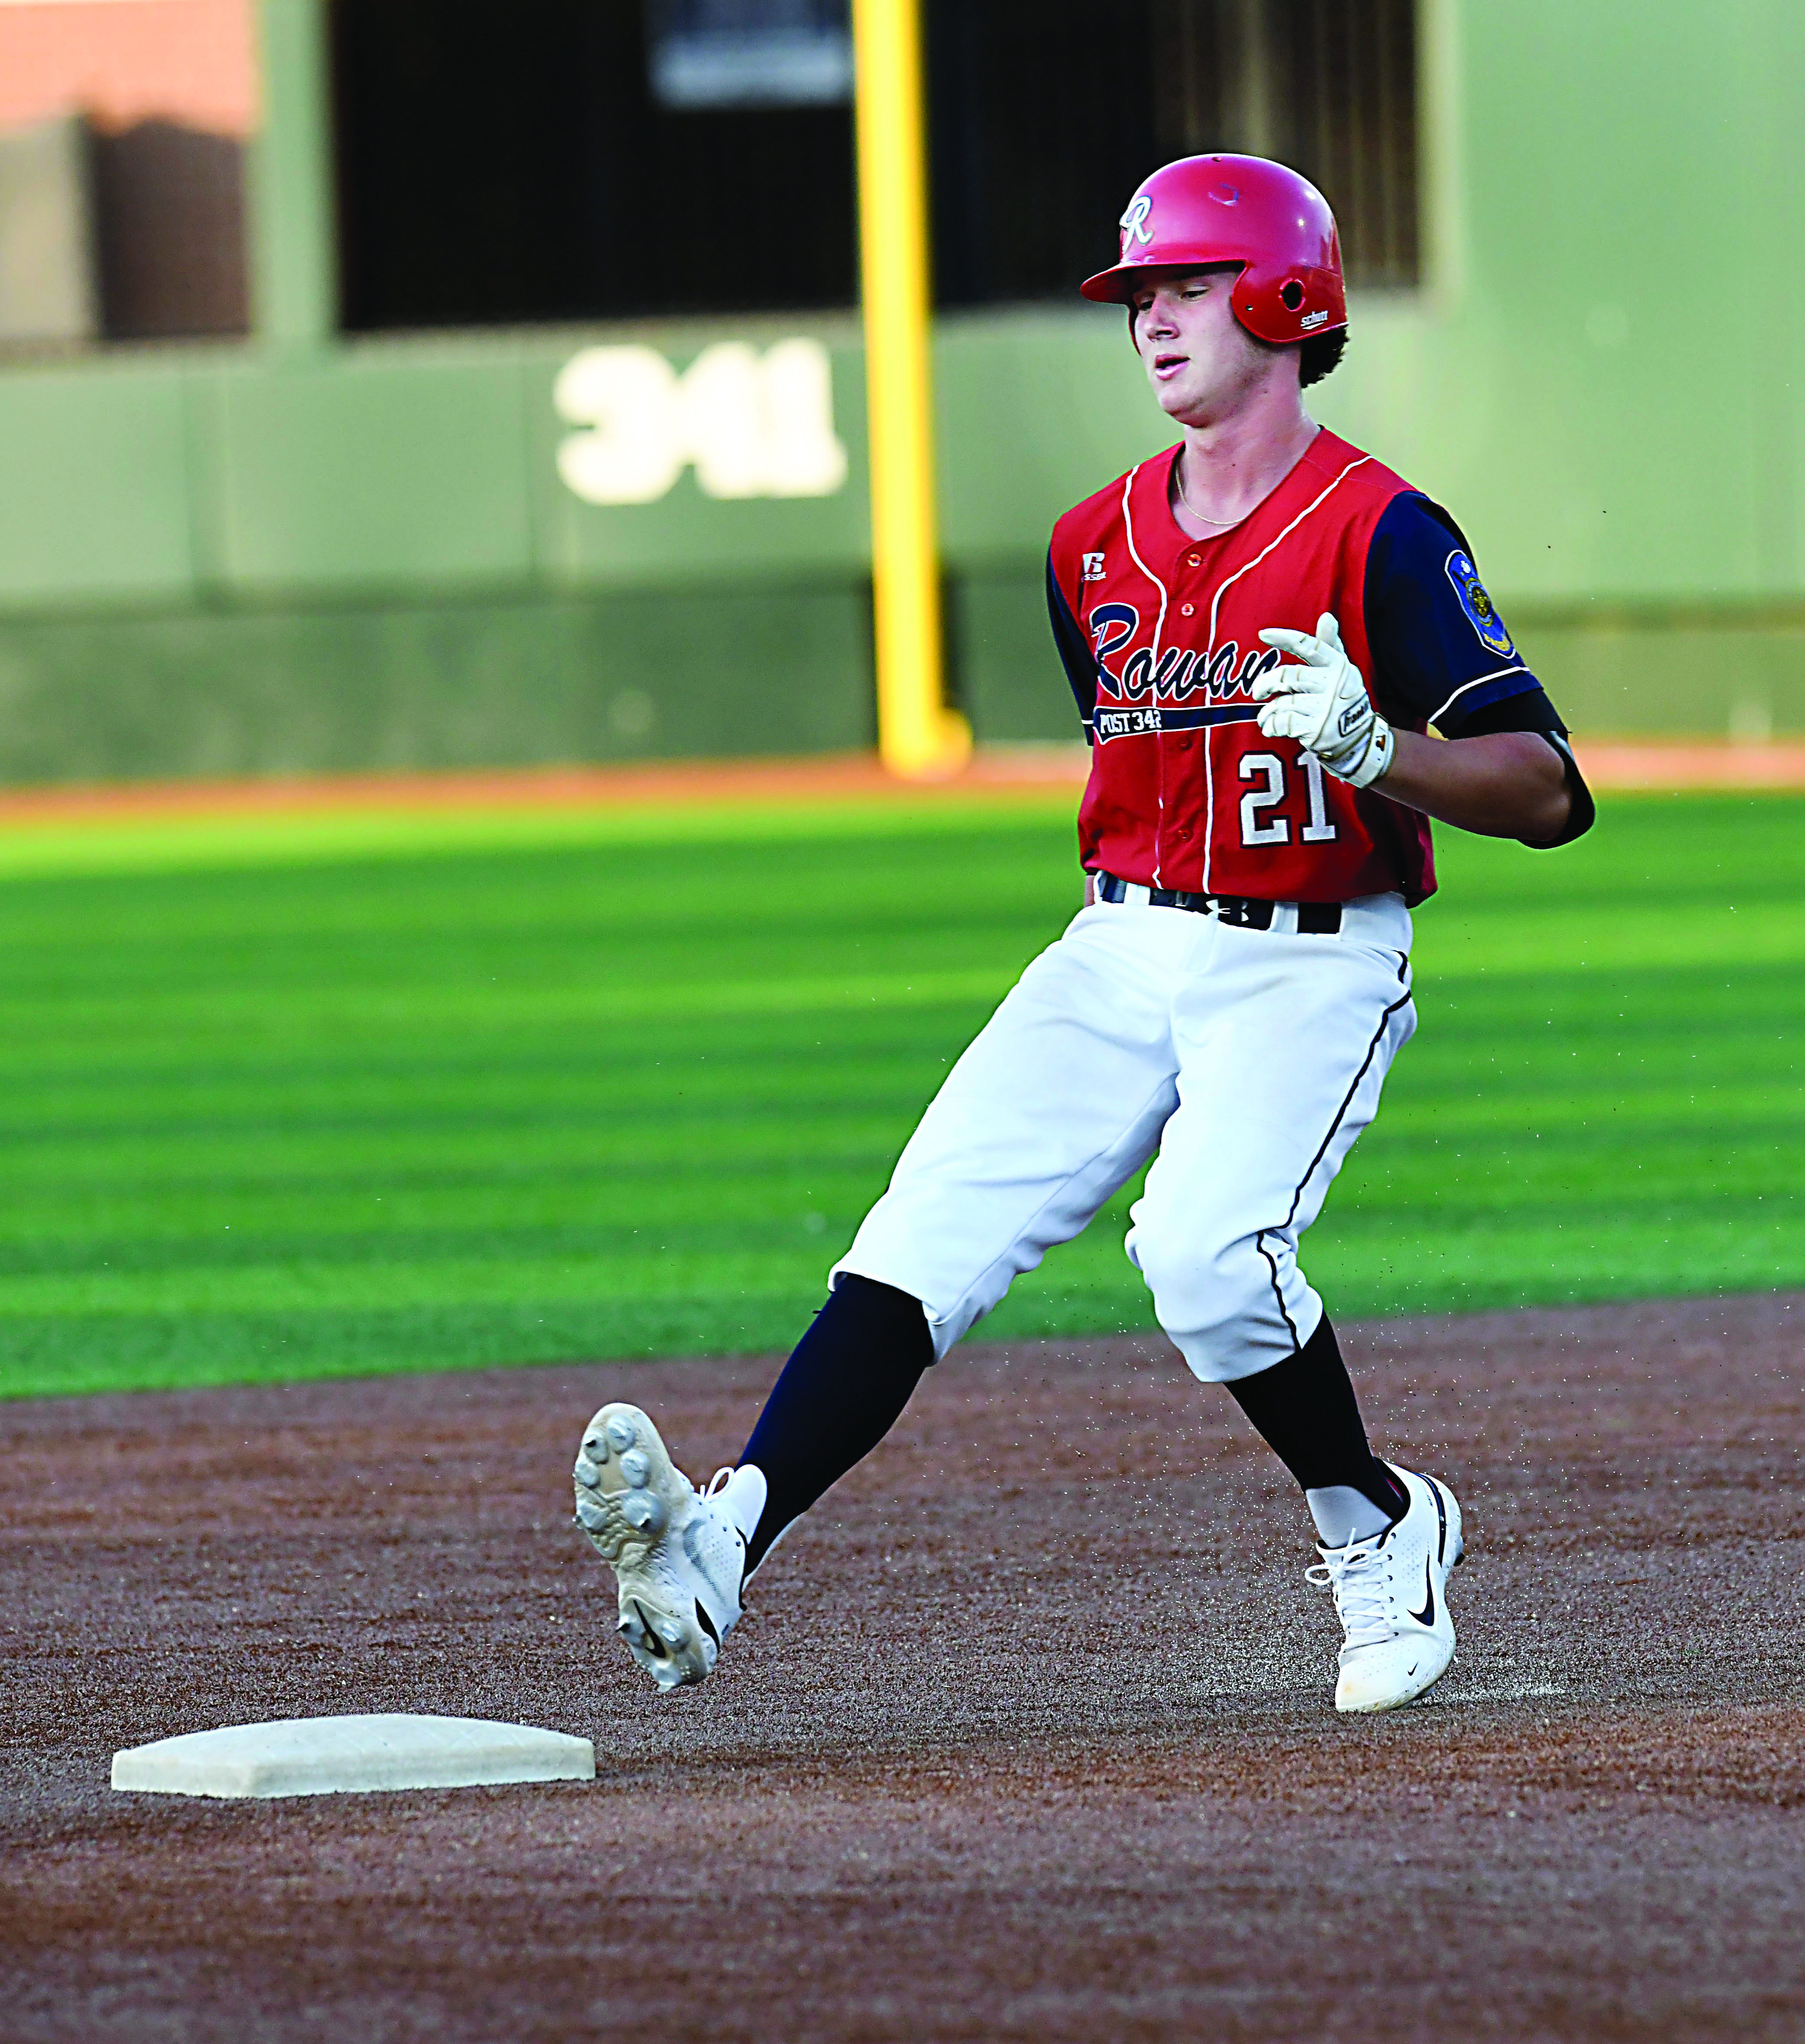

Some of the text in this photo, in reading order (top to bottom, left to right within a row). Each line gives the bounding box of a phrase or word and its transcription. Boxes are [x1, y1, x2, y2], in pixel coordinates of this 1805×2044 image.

[1119, 196, 1153, 253] R
[553, 337, 849, 505] 341
[1090, 603, 1281, 701] Rowan
[1100, 710, 1162, 734] POST 342
[1238, 750, 1340, 849] 21
